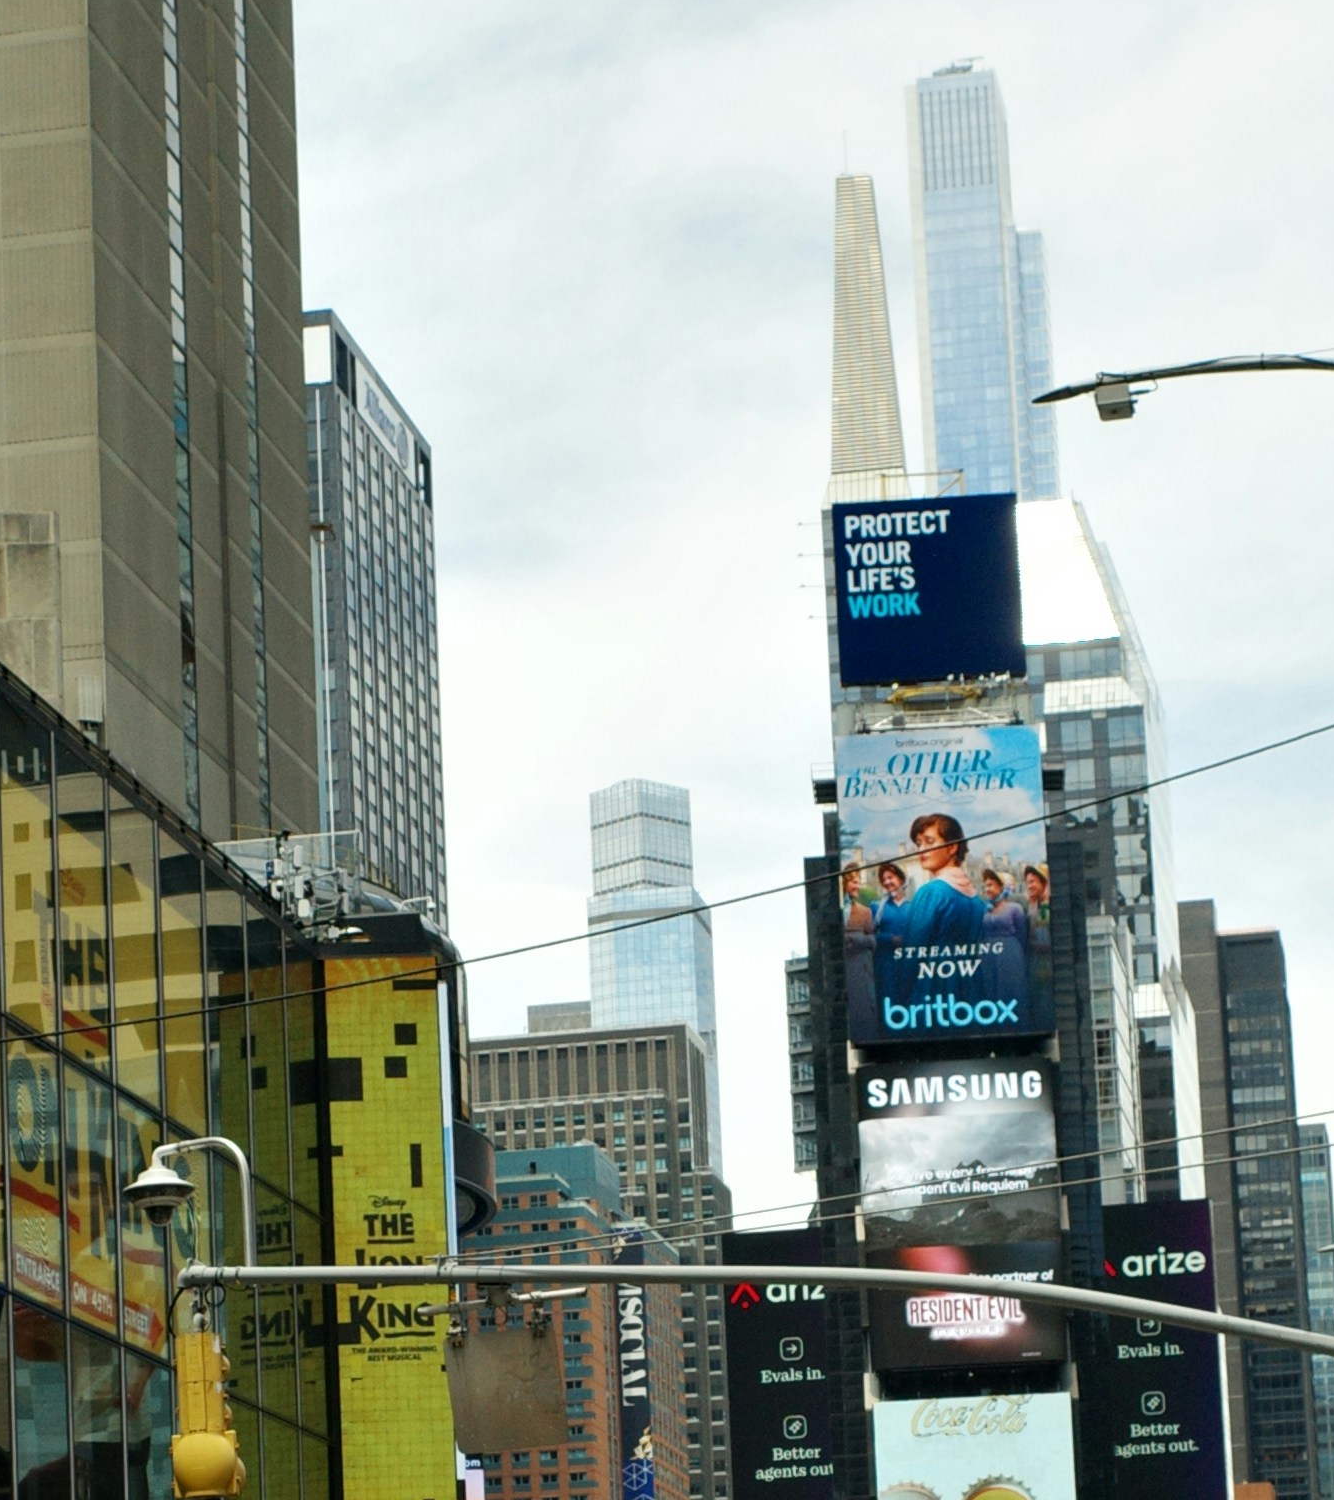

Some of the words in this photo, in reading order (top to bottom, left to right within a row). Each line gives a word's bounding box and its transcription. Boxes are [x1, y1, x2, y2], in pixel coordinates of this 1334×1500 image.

[844, 508, 951, 540] PROTECT
[845, 540, 912, 568] YOUR
[846, 566, 916, 595] LIFE'S
[847, 591, 921, 619] WORK
[886, 749, 994, 777] OTHER
[940, 768, 1017, 794] SISTER
[893, 940, 1005, 961] STREAMING
[917, 959, 983, 981] NOW
[883, 993, 1020, 1031] britbox
[867, 1069, 1044, 1109] SAMSUNG
[363, 1212, 415, 1237] THE
[1122, 1245, 1207, 1278] arize
[348, 1294, 435, 1342] KING
[909, 1297, 983, 1325] RESIDENT
[1117, 1343, 1162, 1360] Evals
[1164, 1341, 1184, 1357] in.
[760, 1368, 803, 1385] Evals
[806, 1367, 826, 1382] in.
[1129, 1421, 1181, 1439] Better
[772, 1445, 822, 1462] Better
[1114, 1440, 1167, 1458] agents
[1168, 1438, 1200, 1454] out.
[755, 1464, 807, 1481] agents
